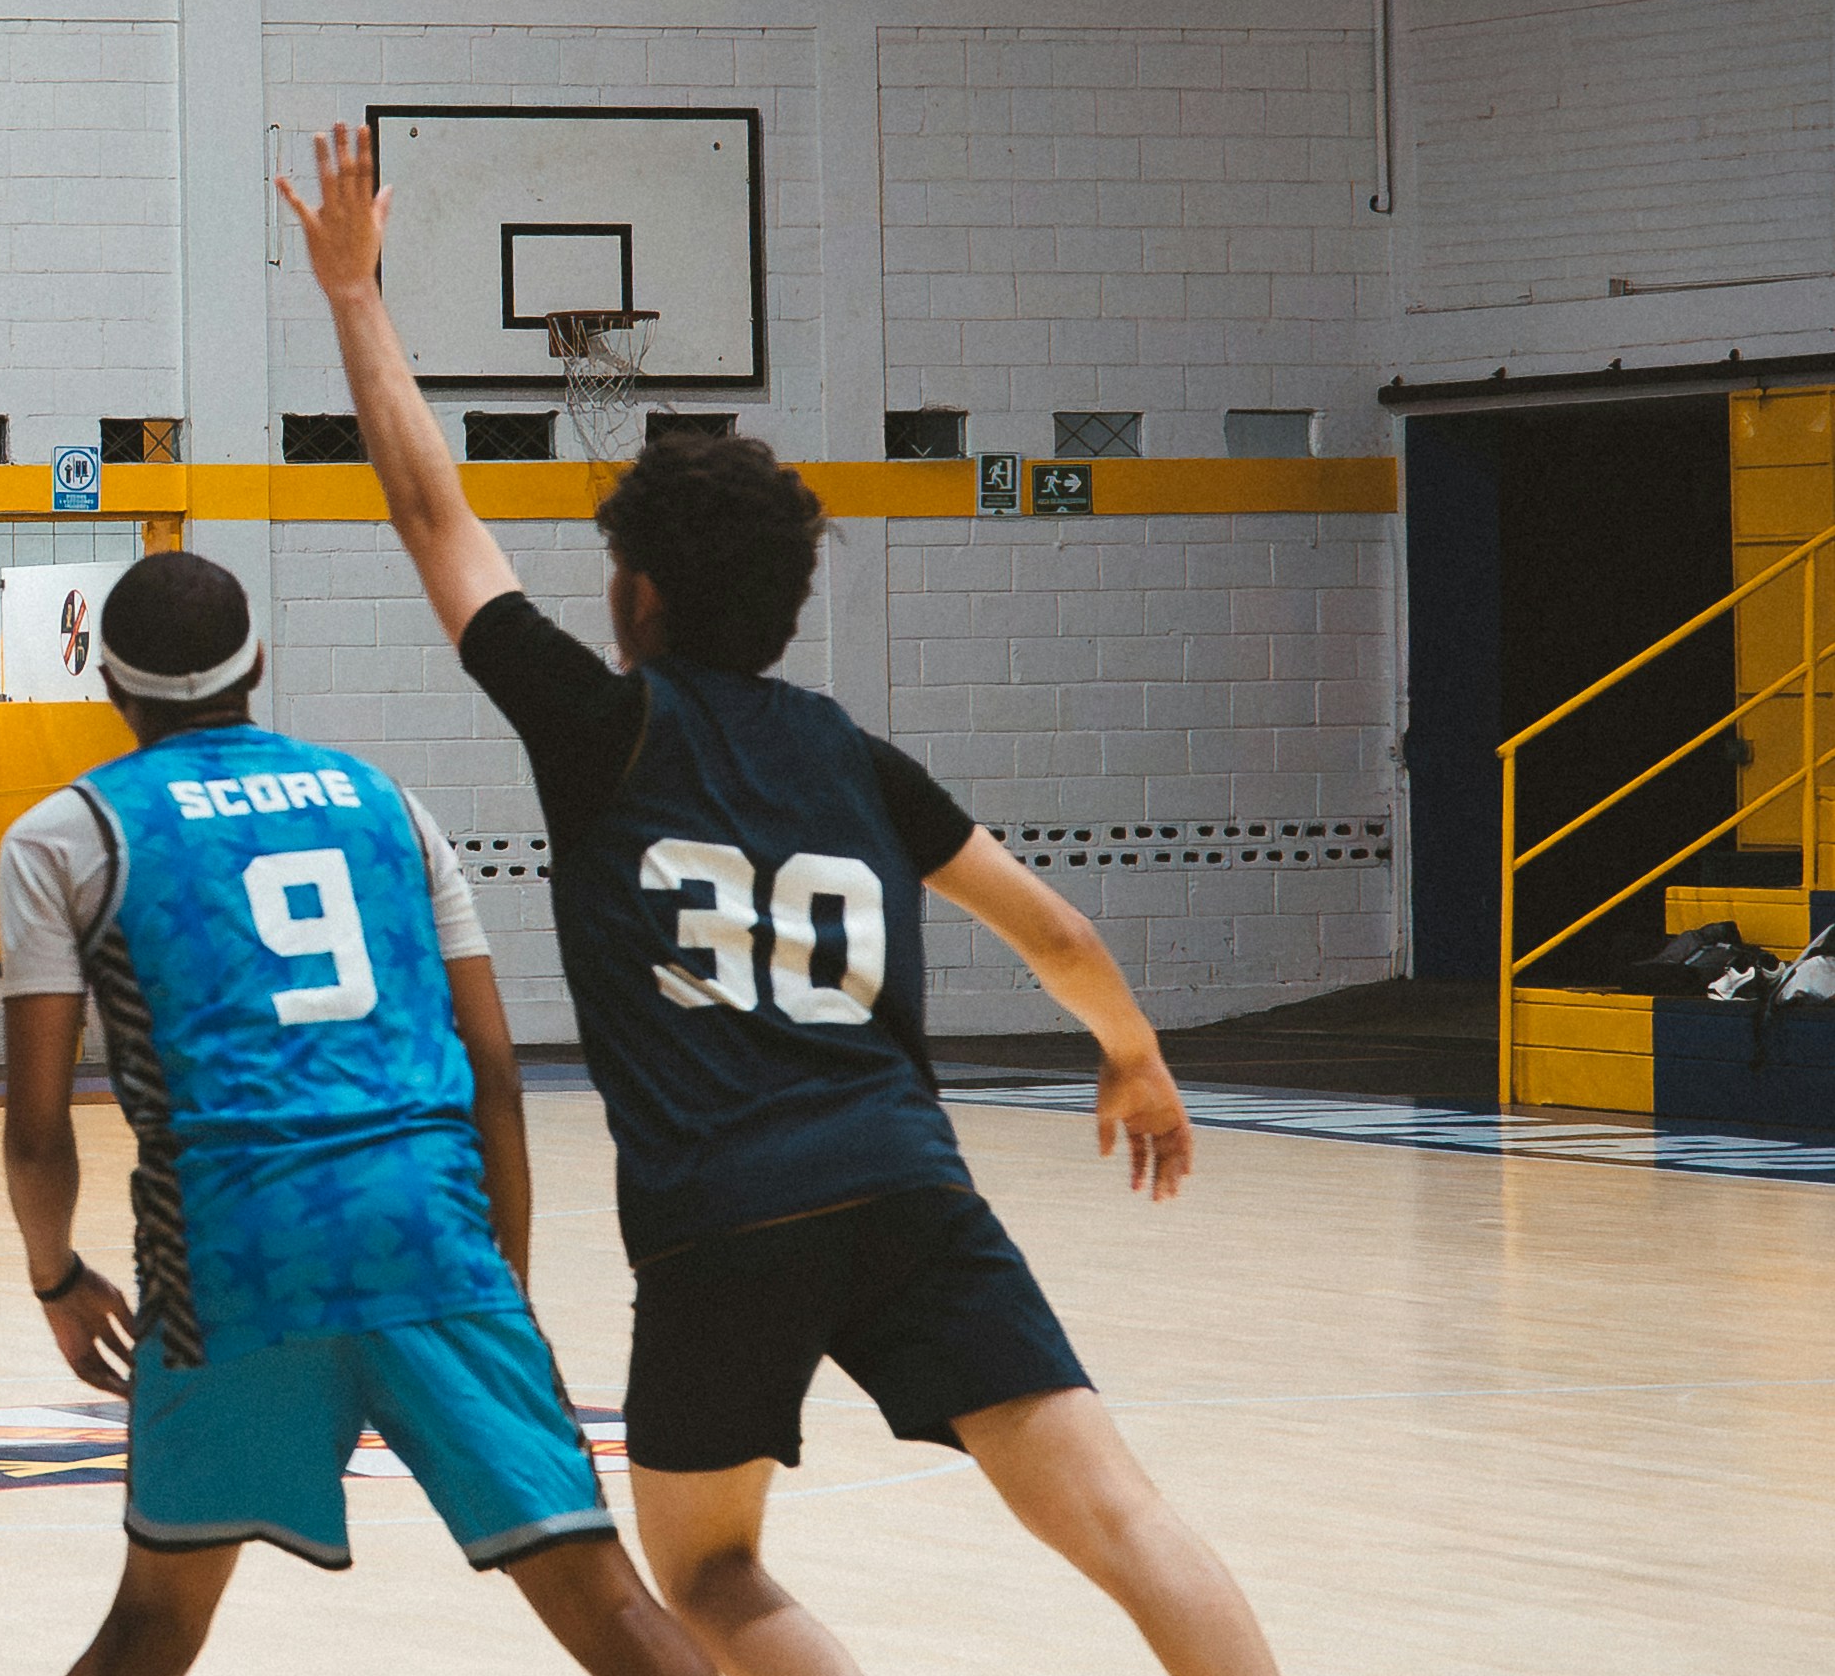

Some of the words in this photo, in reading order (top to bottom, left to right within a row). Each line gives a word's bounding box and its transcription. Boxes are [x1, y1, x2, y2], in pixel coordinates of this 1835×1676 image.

[166, 769, 362, 820] SCORE
[242, 847, 378, 1027] 9
[638, 837, 888, 1026] 30
